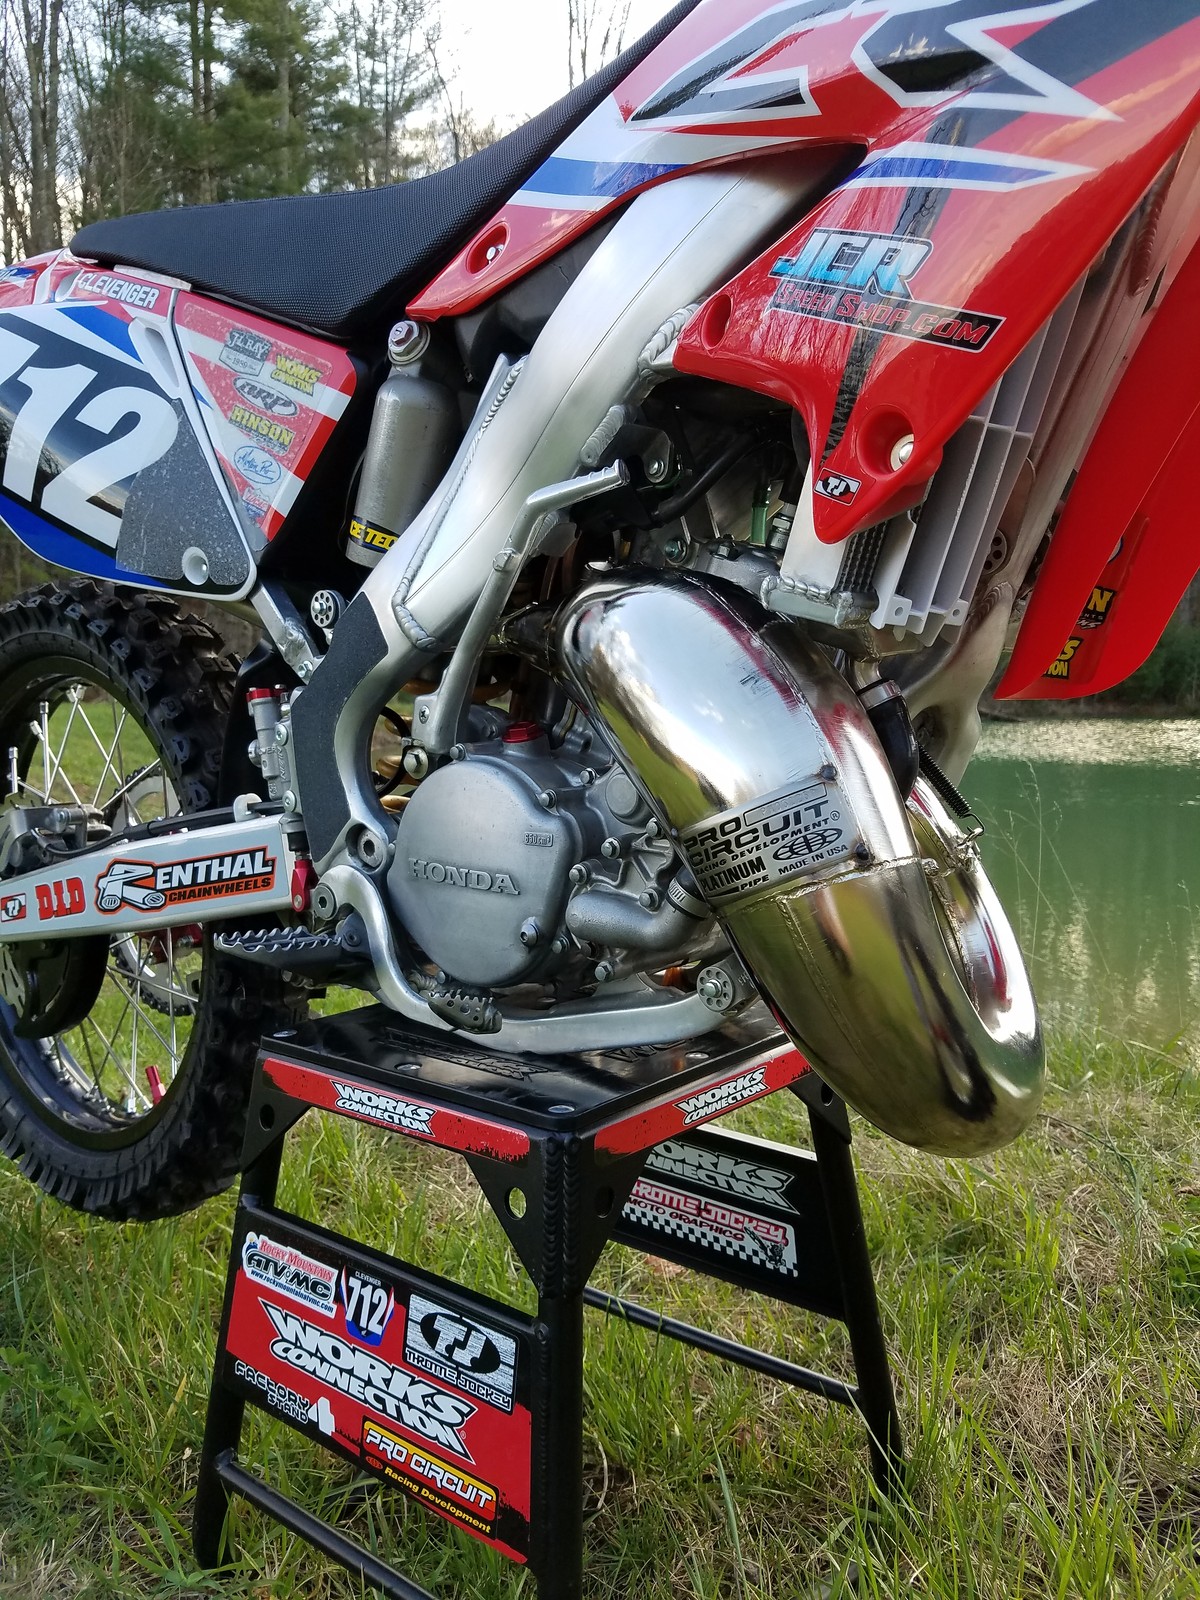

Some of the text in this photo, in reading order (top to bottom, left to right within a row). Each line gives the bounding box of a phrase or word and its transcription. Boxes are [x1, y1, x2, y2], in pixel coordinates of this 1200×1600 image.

[770, 230, 931, 295] JCR
[78, 272, 160, 309] CLEVENGER
[775, 282, 836, 313] SPEED
[275, 354, 321, 384] WORKS
[230, 405, 294, 446] HINSON
[683, 816, 742, 852] PRO
[688, 799, 829, 868] CIRCUIT
[731, 817, 830, 862] DEVELOPMENT
[408, 857, 521, 896] HONDA
[700, 855, 767, 894] PLATINUM
[778, 844, 848, 875] MADE IN USA
[168, 876, 272, 903] CHAINWHEELS
[740, 874, 769, 891] PIPE
[332, 1080, 435, 1122] WORKS
[675, 1067, 767, 1112] WORKS
[683, 1082, 769, 1125] CONNECTION
[336, 1098, 433, 1136] CONNECTION
[645, 1153, 792, 1209] NNECTION
[652, 1140, 792, 1190] ORKS
[630, 1181, 787, 1245] HROTTLE JOCKEY
[669, 1211, 745, 1242] GRAPHICS
[260, 1240, 335, 1283] ROCKY MOUNTAIN
[355, 1270, 382, 1287] CLEVENGER
[250, 1268, 334, 1314] www.rockymountainatvmc.com
[345, 1276, 388, 1336] 712
[260, 1299, 475, 1425] WORKS
[405, 1347, 512, 1412] THROTTLE JOCKEY
[235, 1360, 310, 1411] FACTORY
[271, 1339, 472, 1460] CONNECTION
[268, 1393, 309, 1425] STAND
[365, 1428, 493, 1508] PRO CIRCUIT
[384, 1466, 492, 1535] Racing Development
